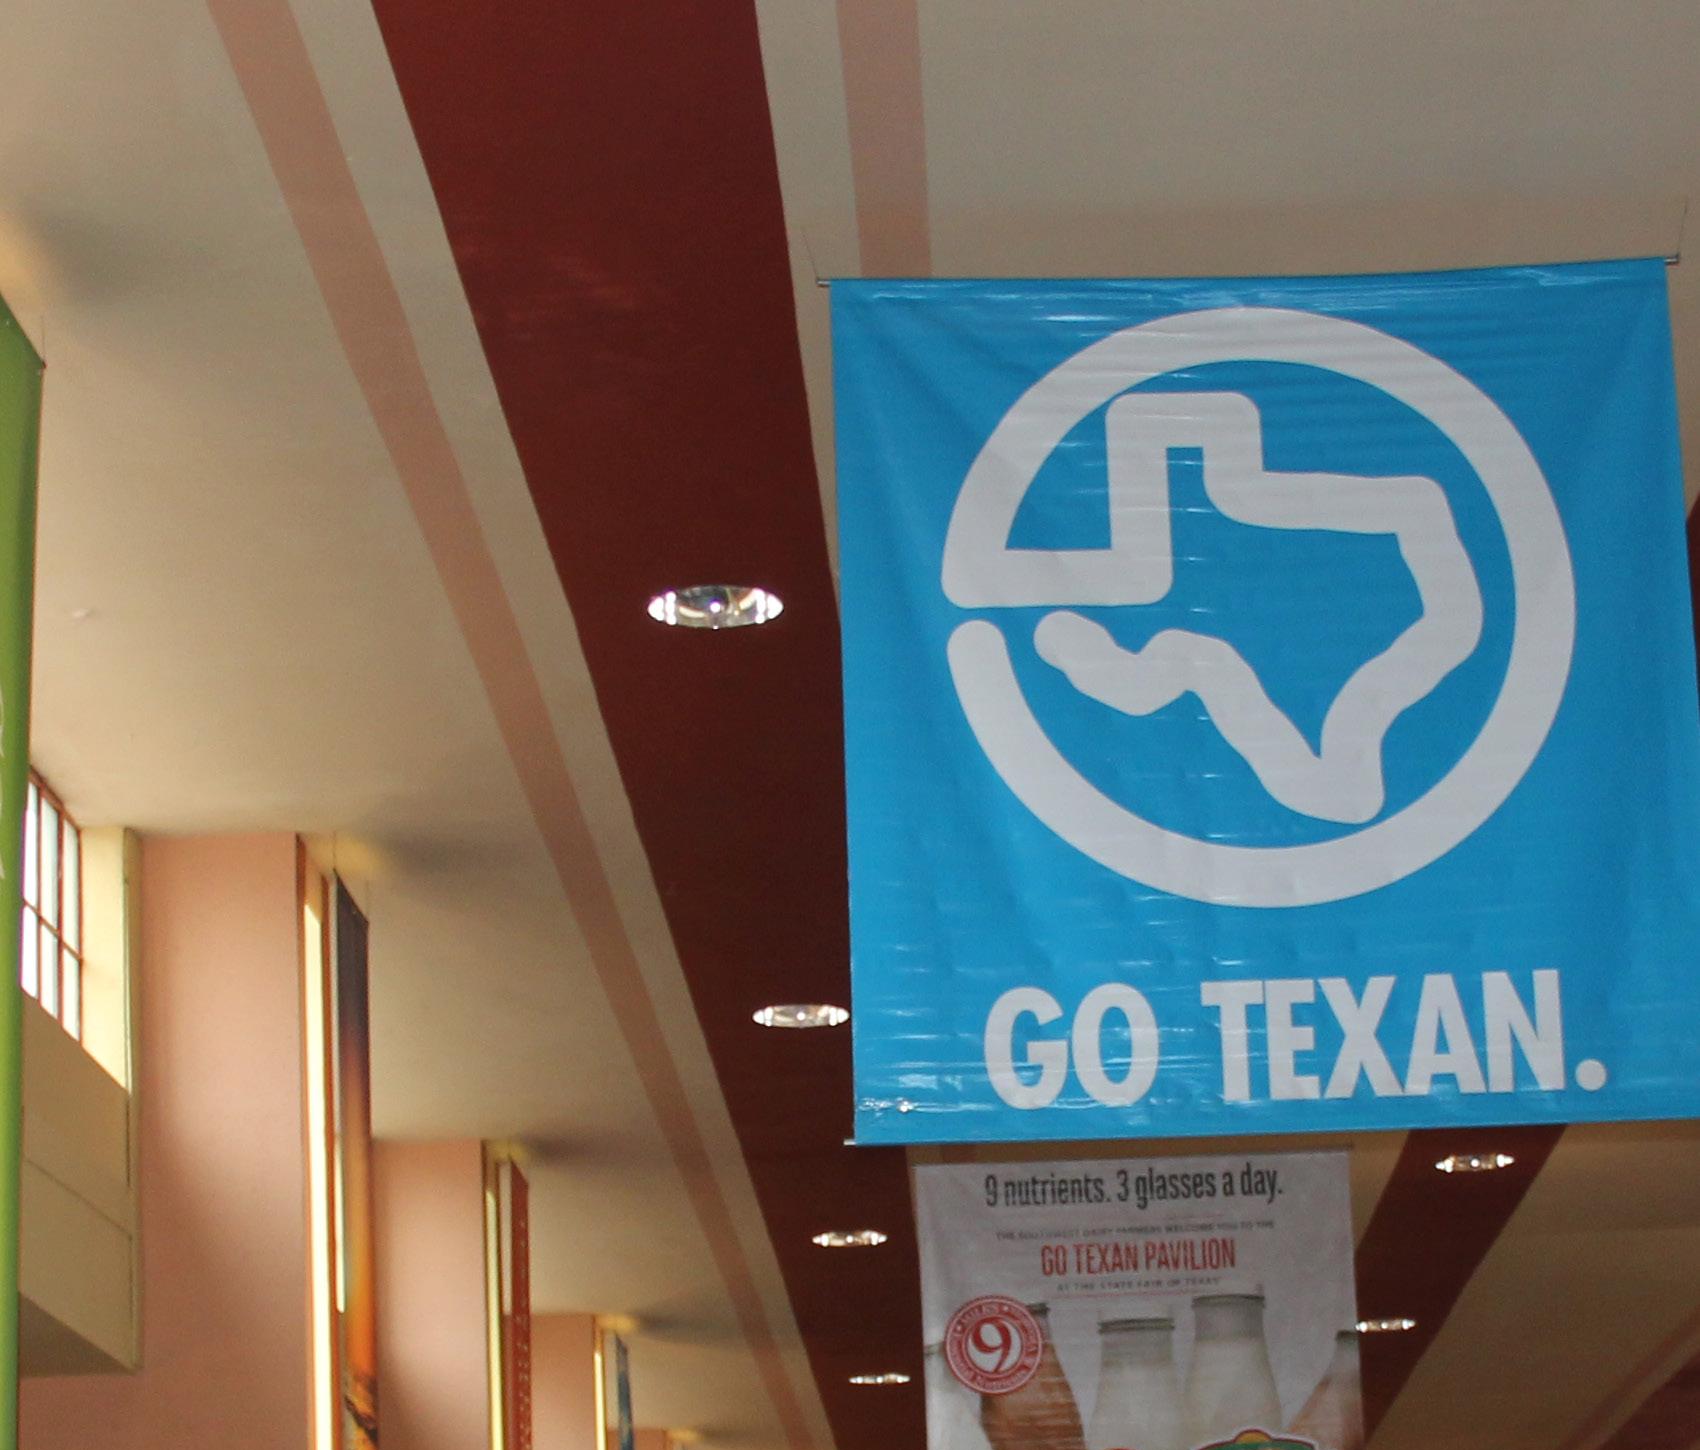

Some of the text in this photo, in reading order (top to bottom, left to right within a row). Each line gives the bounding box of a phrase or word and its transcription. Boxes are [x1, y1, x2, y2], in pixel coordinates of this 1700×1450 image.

[984, 969, 1608, 1110] GO TEXAN.
[985, 1162, 1284, 1210] 9 nutrients. 3 glasses a day.
[1040, 1237, 1237, 1277] GO TEXAN PAVILION
[972, 1316, 1012, 1373] 9
